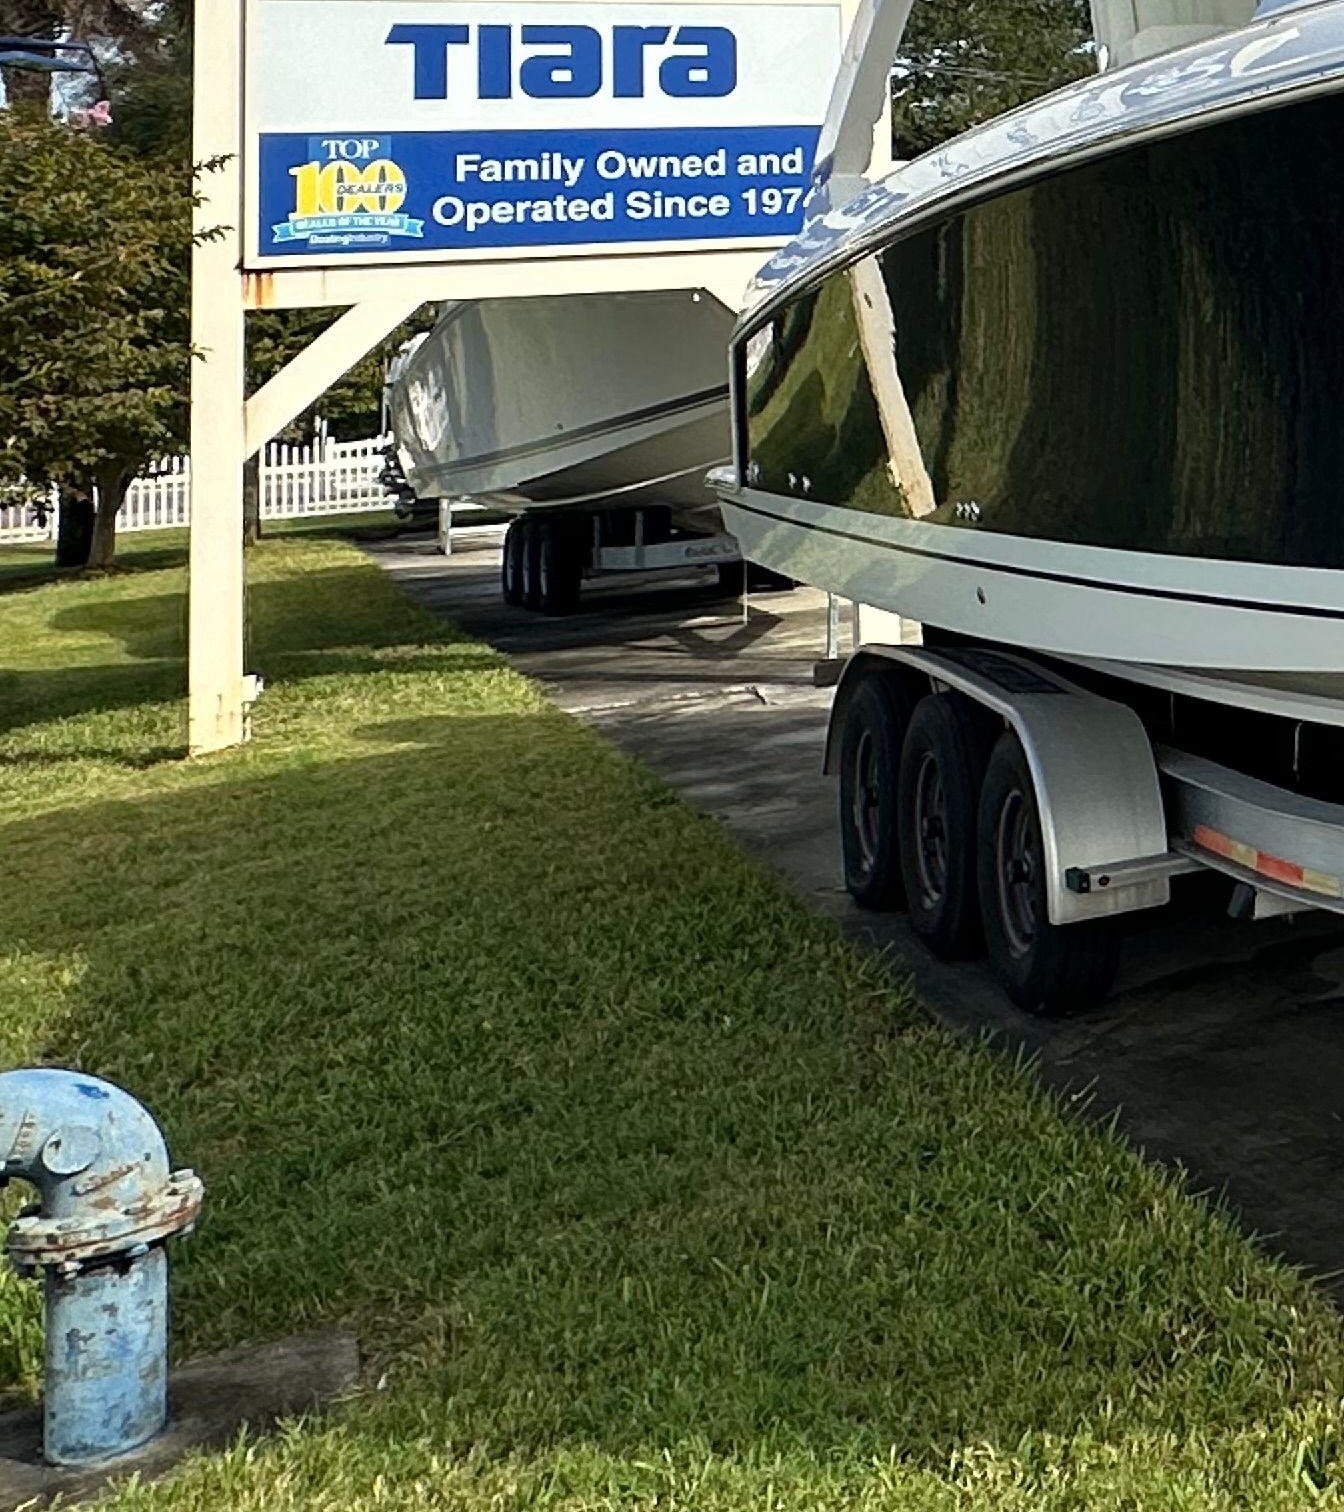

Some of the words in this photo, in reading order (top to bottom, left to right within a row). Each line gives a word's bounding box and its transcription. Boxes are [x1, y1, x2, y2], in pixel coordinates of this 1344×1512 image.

[321, 139, 380, 159] TOP
[456, 152, 584, 187] Family
[596, 149, 726, 180] Owned
[737, 147, 803, 175] and
[289, 161, 408, 219] 100
[432, 192, 615, 231] Operated
[626, 189, 730, 219] Since
